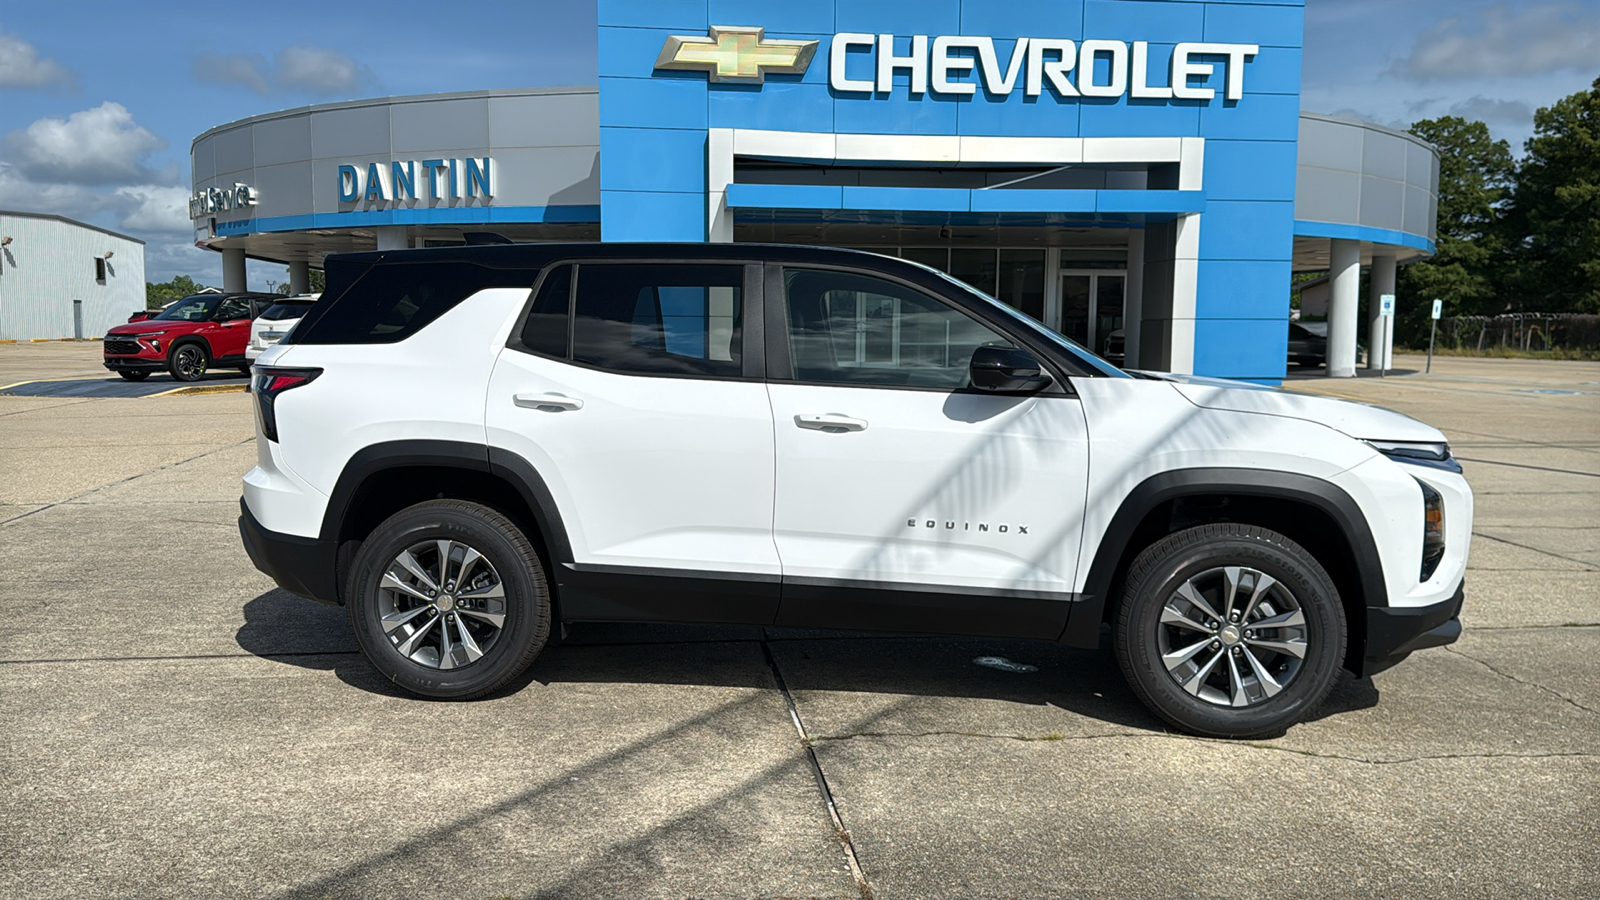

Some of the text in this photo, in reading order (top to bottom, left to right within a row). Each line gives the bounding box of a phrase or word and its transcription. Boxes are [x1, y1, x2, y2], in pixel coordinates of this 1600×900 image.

[830, 32, 1260, 100] CHEVROLET
[208, 182, 256, 212] Service
[338, 156, 494, 202] DANTIN
[907, 518, 1029, 535] EQUINOX
